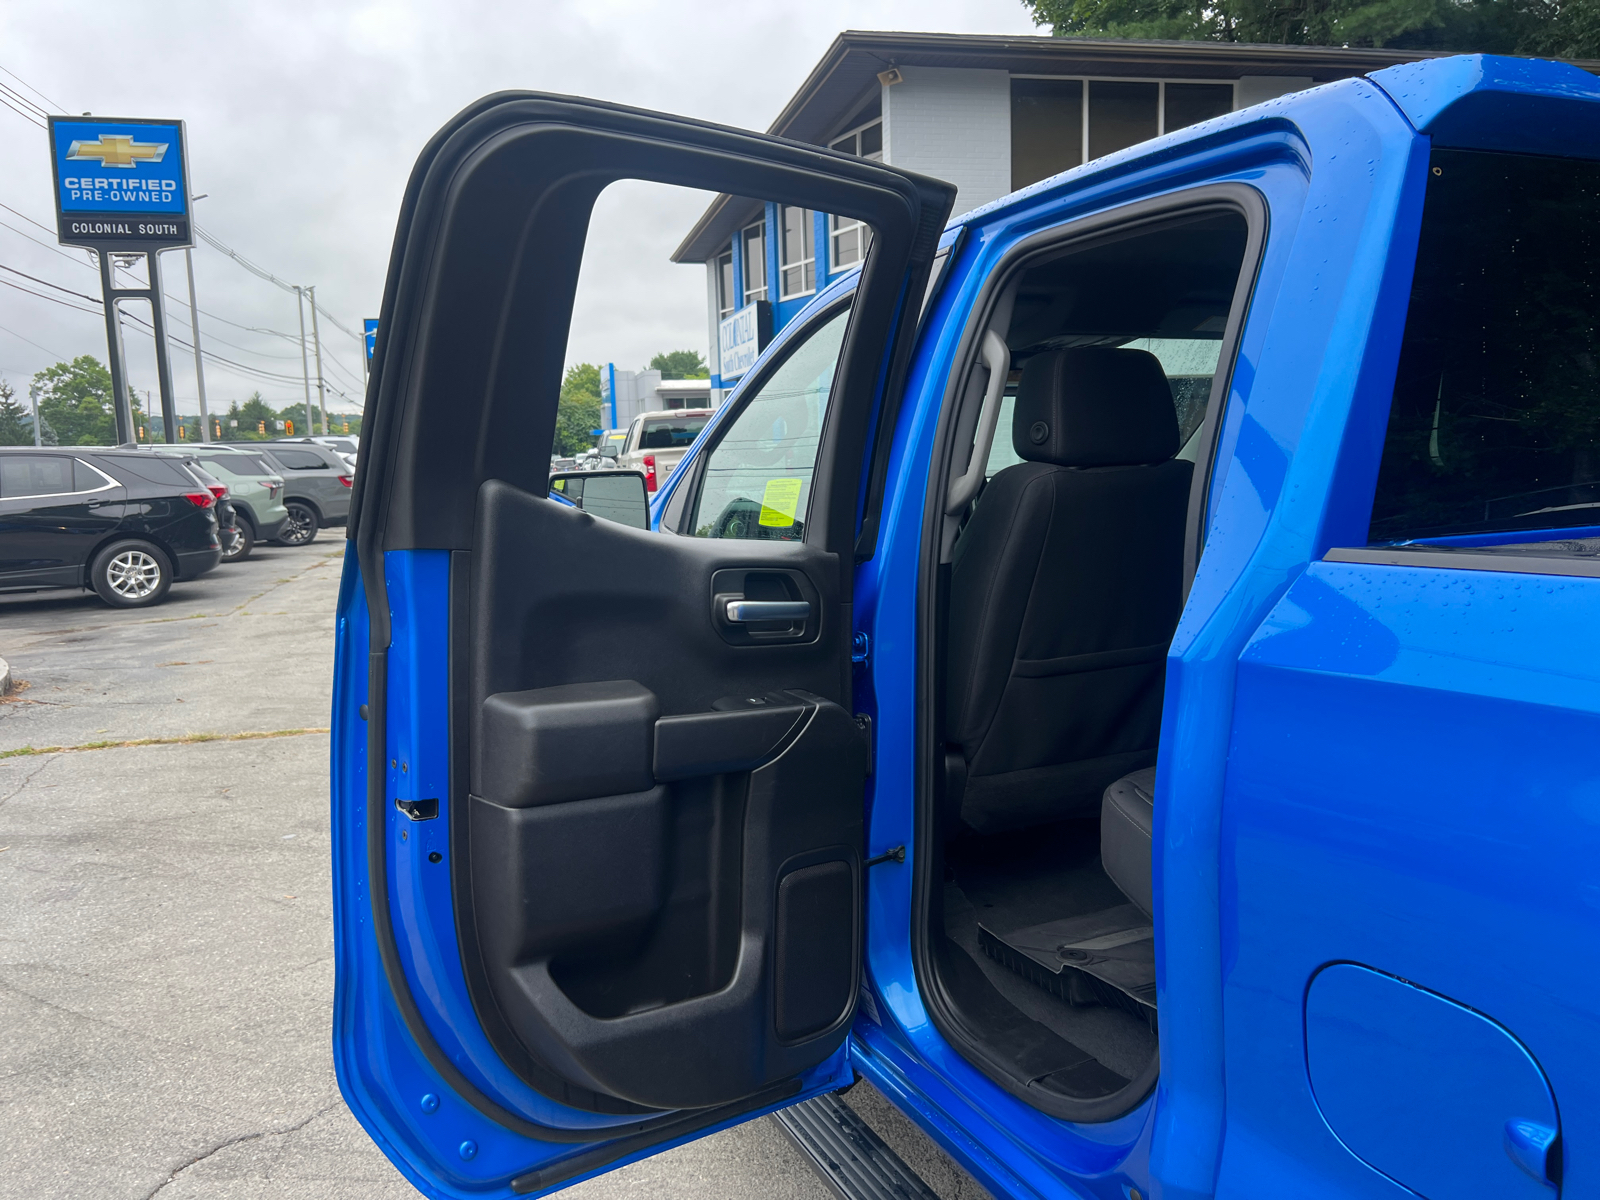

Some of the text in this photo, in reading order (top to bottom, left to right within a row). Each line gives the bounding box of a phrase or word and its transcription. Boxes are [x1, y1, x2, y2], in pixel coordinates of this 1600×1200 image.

[64, 177, 176, 190] CERTIFIED
[71, 190, 172, 202] PRE-OWNED
[71, 222, 177, 234] COLONIAL SOUTH
